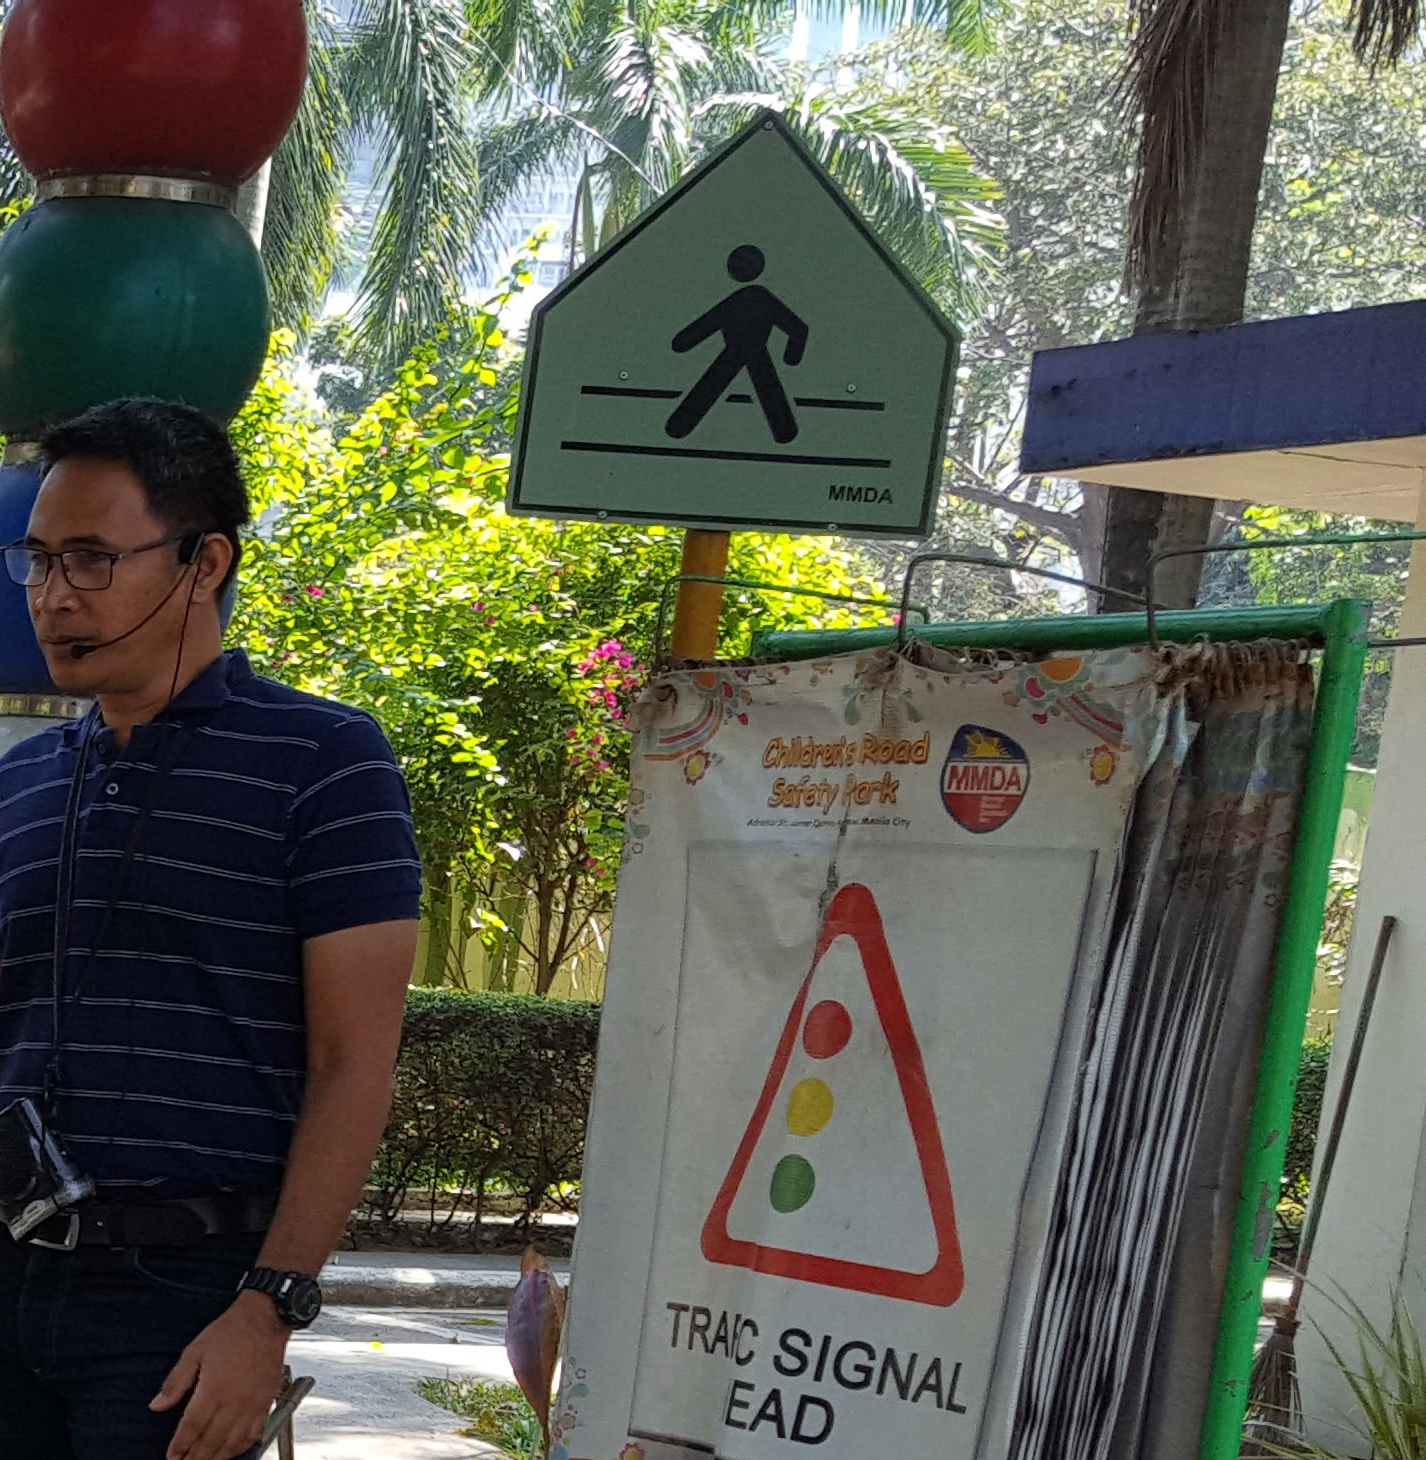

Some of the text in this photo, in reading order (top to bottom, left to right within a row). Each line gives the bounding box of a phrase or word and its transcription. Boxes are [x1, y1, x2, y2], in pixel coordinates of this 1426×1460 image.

[829, 485, 893, 504] MMDA
[762, 731, 931, 769] Children's Road
[767, 775, 840, 815] Safety
[947, 765, 1022, 792] MMDA
[772, 1327, 968, 1415] SIGNAL
[724, 1378, 835, 1445] EAD
